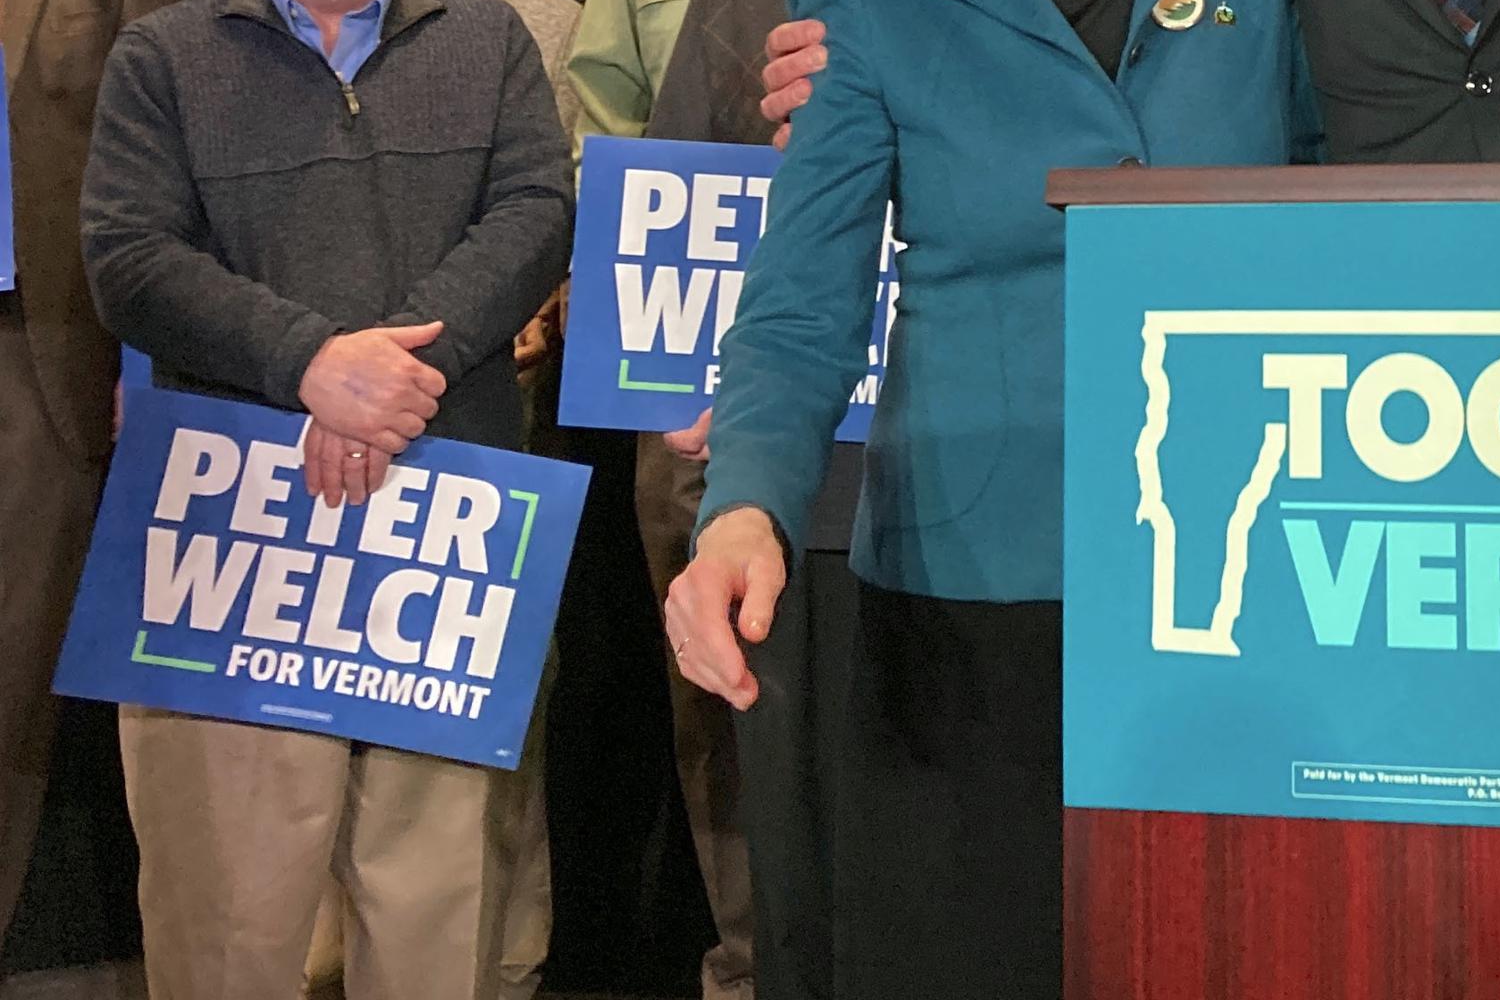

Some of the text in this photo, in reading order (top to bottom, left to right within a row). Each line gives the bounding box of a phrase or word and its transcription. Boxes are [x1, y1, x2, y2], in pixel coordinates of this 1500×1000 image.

[142, 527, 516, 680] WELCH
[225, 645, 491, 720] FOR VERMONT
[1303, 767, 1326, 780] Paid
[1327, 769, 1342, 781] for
[1343, 770, 1357, 784] by
[1358, 771, 1376, 783] the
[1377, 771, 1419, 785] Vermont
